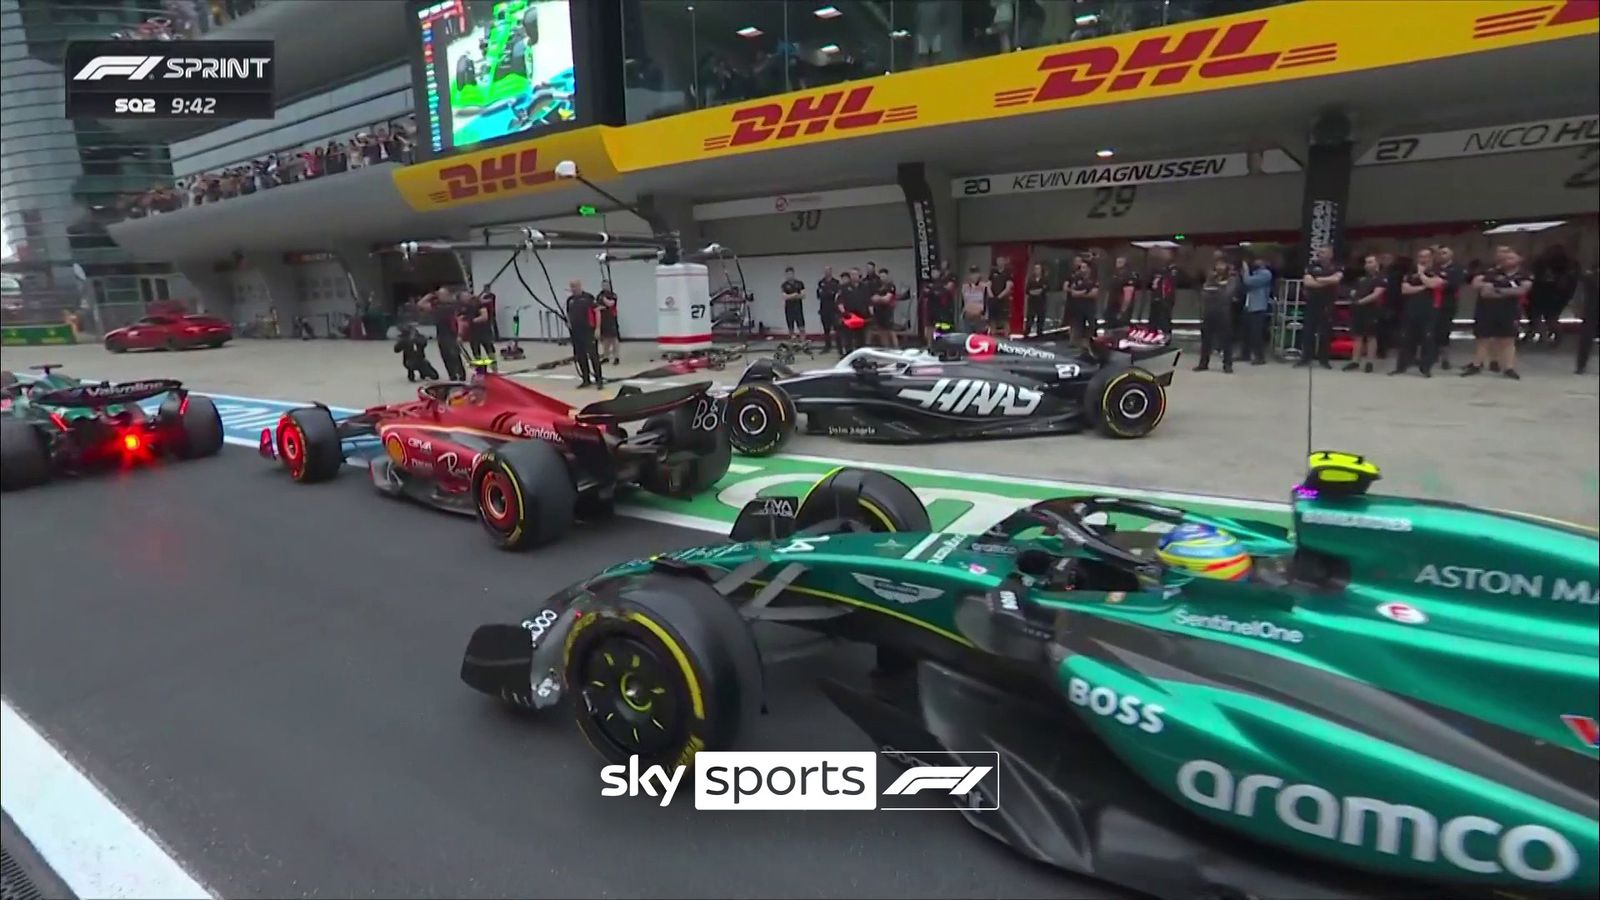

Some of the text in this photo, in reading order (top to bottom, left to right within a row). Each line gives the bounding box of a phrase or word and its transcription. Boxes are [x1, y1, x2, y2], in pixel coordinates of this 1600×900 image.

[1033, 20, 1282, 102] DHL
[729, 85, 886, 146] DHL
[1375, 137, 1420, 161] 27
[1463, 124, 1549, 152] NICO
[440, 148, 557, 200] DHL
[964, 158, 1226, 195] 20 KEVIN MAGNUSSEN
[791, 209, 821, 231] 30
[1087, 186, 1137, 218] 29
[691, 304, 706, 319] 27
[998, 343, 1055, 360] MoneyGram
[1055, 364, 1081, 378] 27
[897, 378, 1044, 416] HAAS
[1415, 564, 1543, 597] ASTON
[1174, 608, 1304, 643] SentinelOne
[1068, 677, 1165, 733] BOSS
[1176, 759, 1580, 882] aramco
